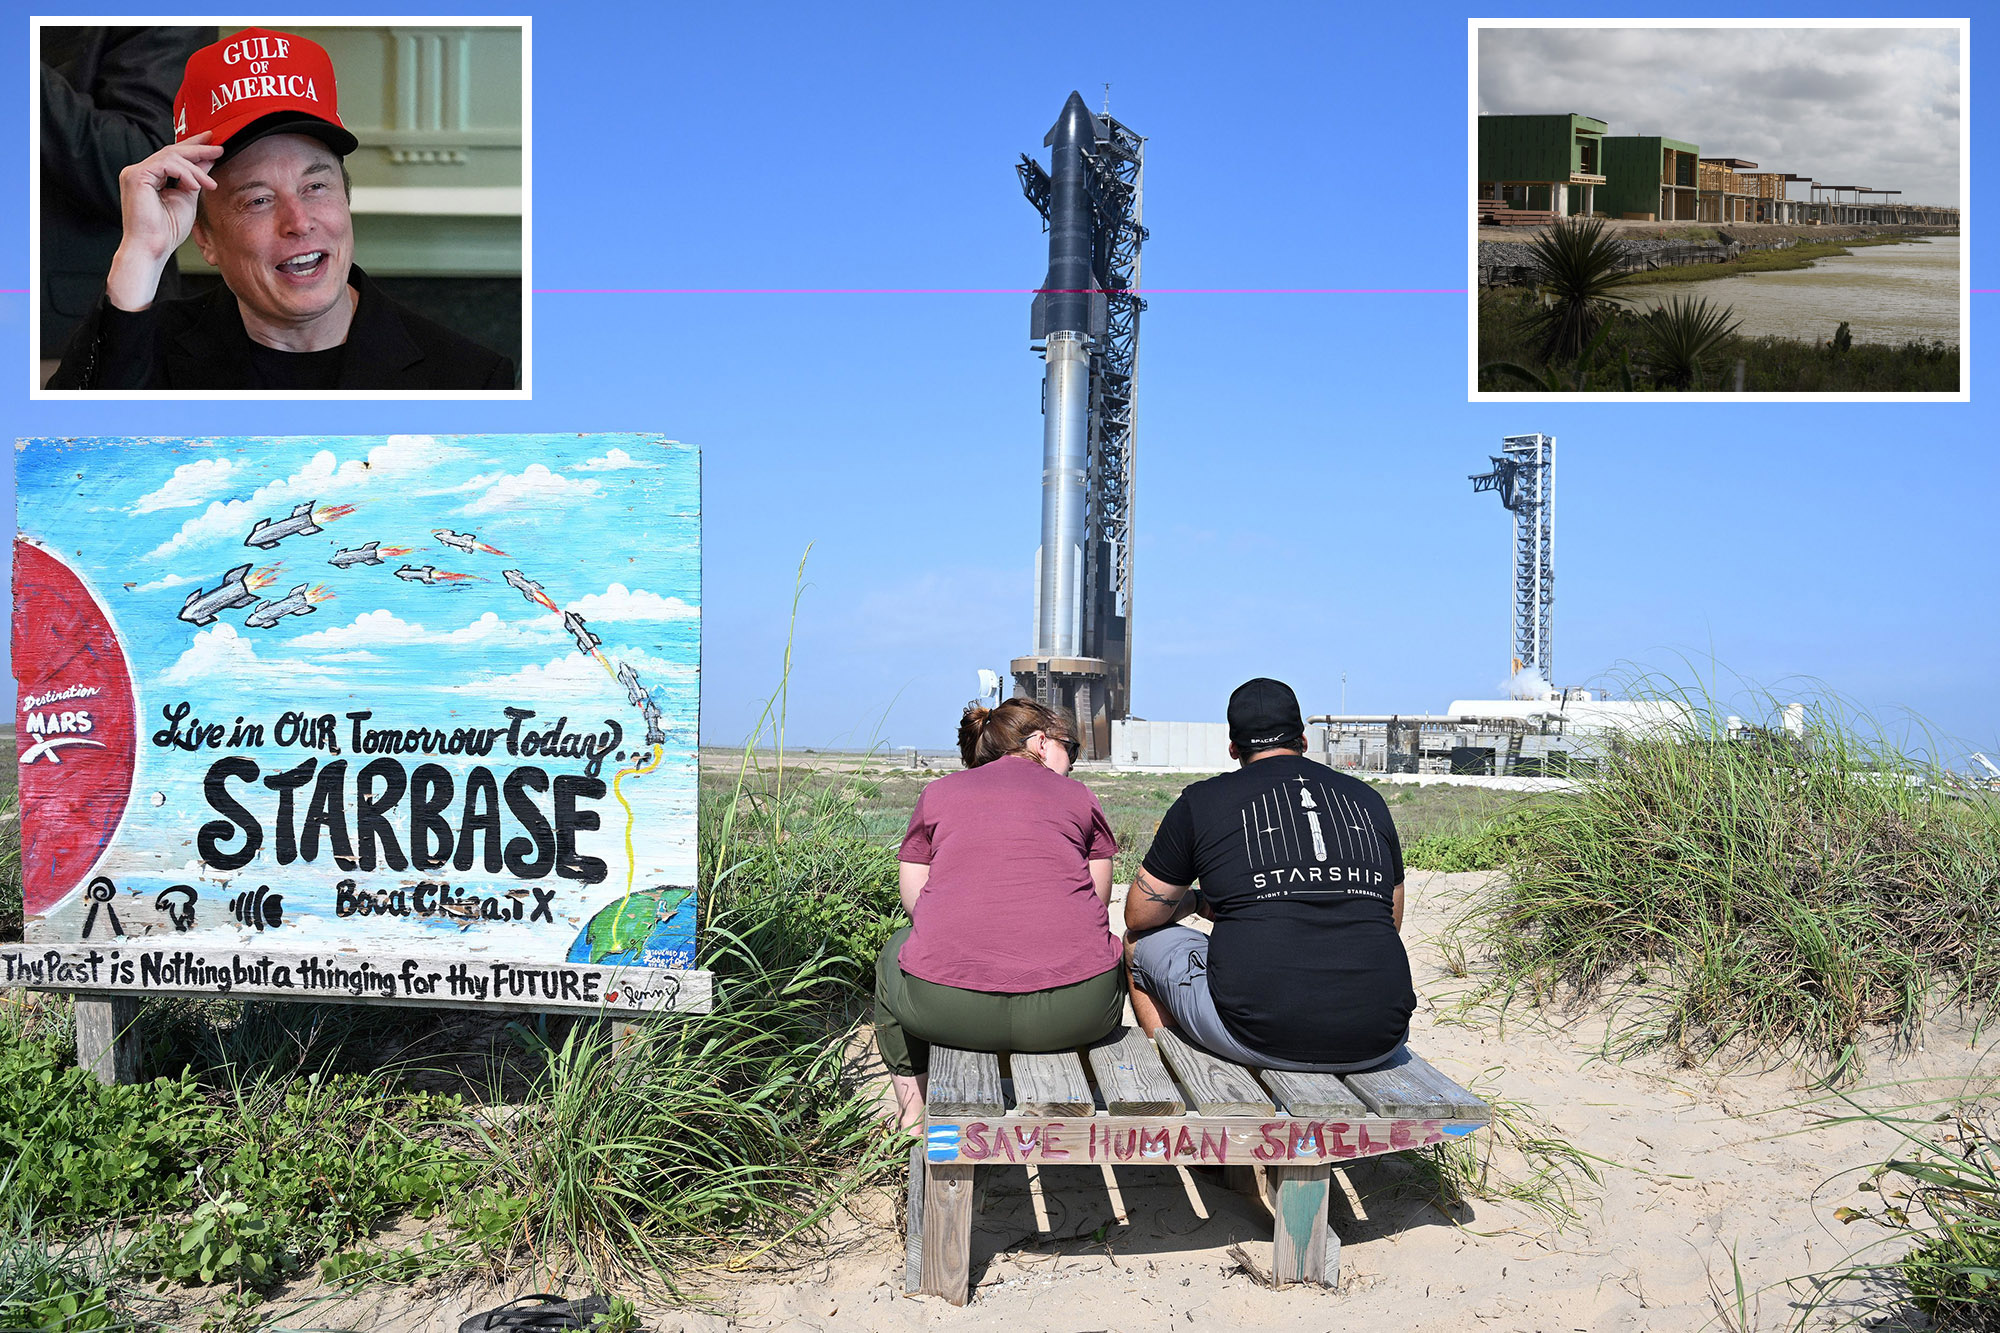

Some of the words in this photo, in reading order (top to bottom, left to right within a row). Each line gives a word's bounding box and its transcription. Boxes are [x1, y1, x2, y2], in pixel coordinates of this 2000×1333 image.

[223, 37, 290, 65] GULF
[250, 61, 270, 75] OF
[210, 75, 319, 115] AMERICA
[23, 683, 102, 712] Destination
[26, 710, 93, 734] MARS
[152, 701, 226, 750] Live
[226, 716, 265, 748] in
[274, 711, 342, 756] OUR
[346, 710, 500, 756] Tomorrow
[198, 756, 608, 882] STARBASE
[1253, 867, 1383, 889] STARSHIP
[1, 952, 44, 985] Thy
[43, 950, 104, 984] Past
[110, 950, 136, 985] is
[140, 951, 233, 992] Nothing
[233, 954, 274, 985] but
[270, 965, 294, 988] a
[296, 956, 397, 998] thinging
[399, 959, 442, 995] for
[446, 963, 489, 1000] thy
[490, 963, 601, 1002] FUTURE
[961, 1122, 1070, 1163] SAVE
[1088, 1122, 1228, 1164] HUMAN
